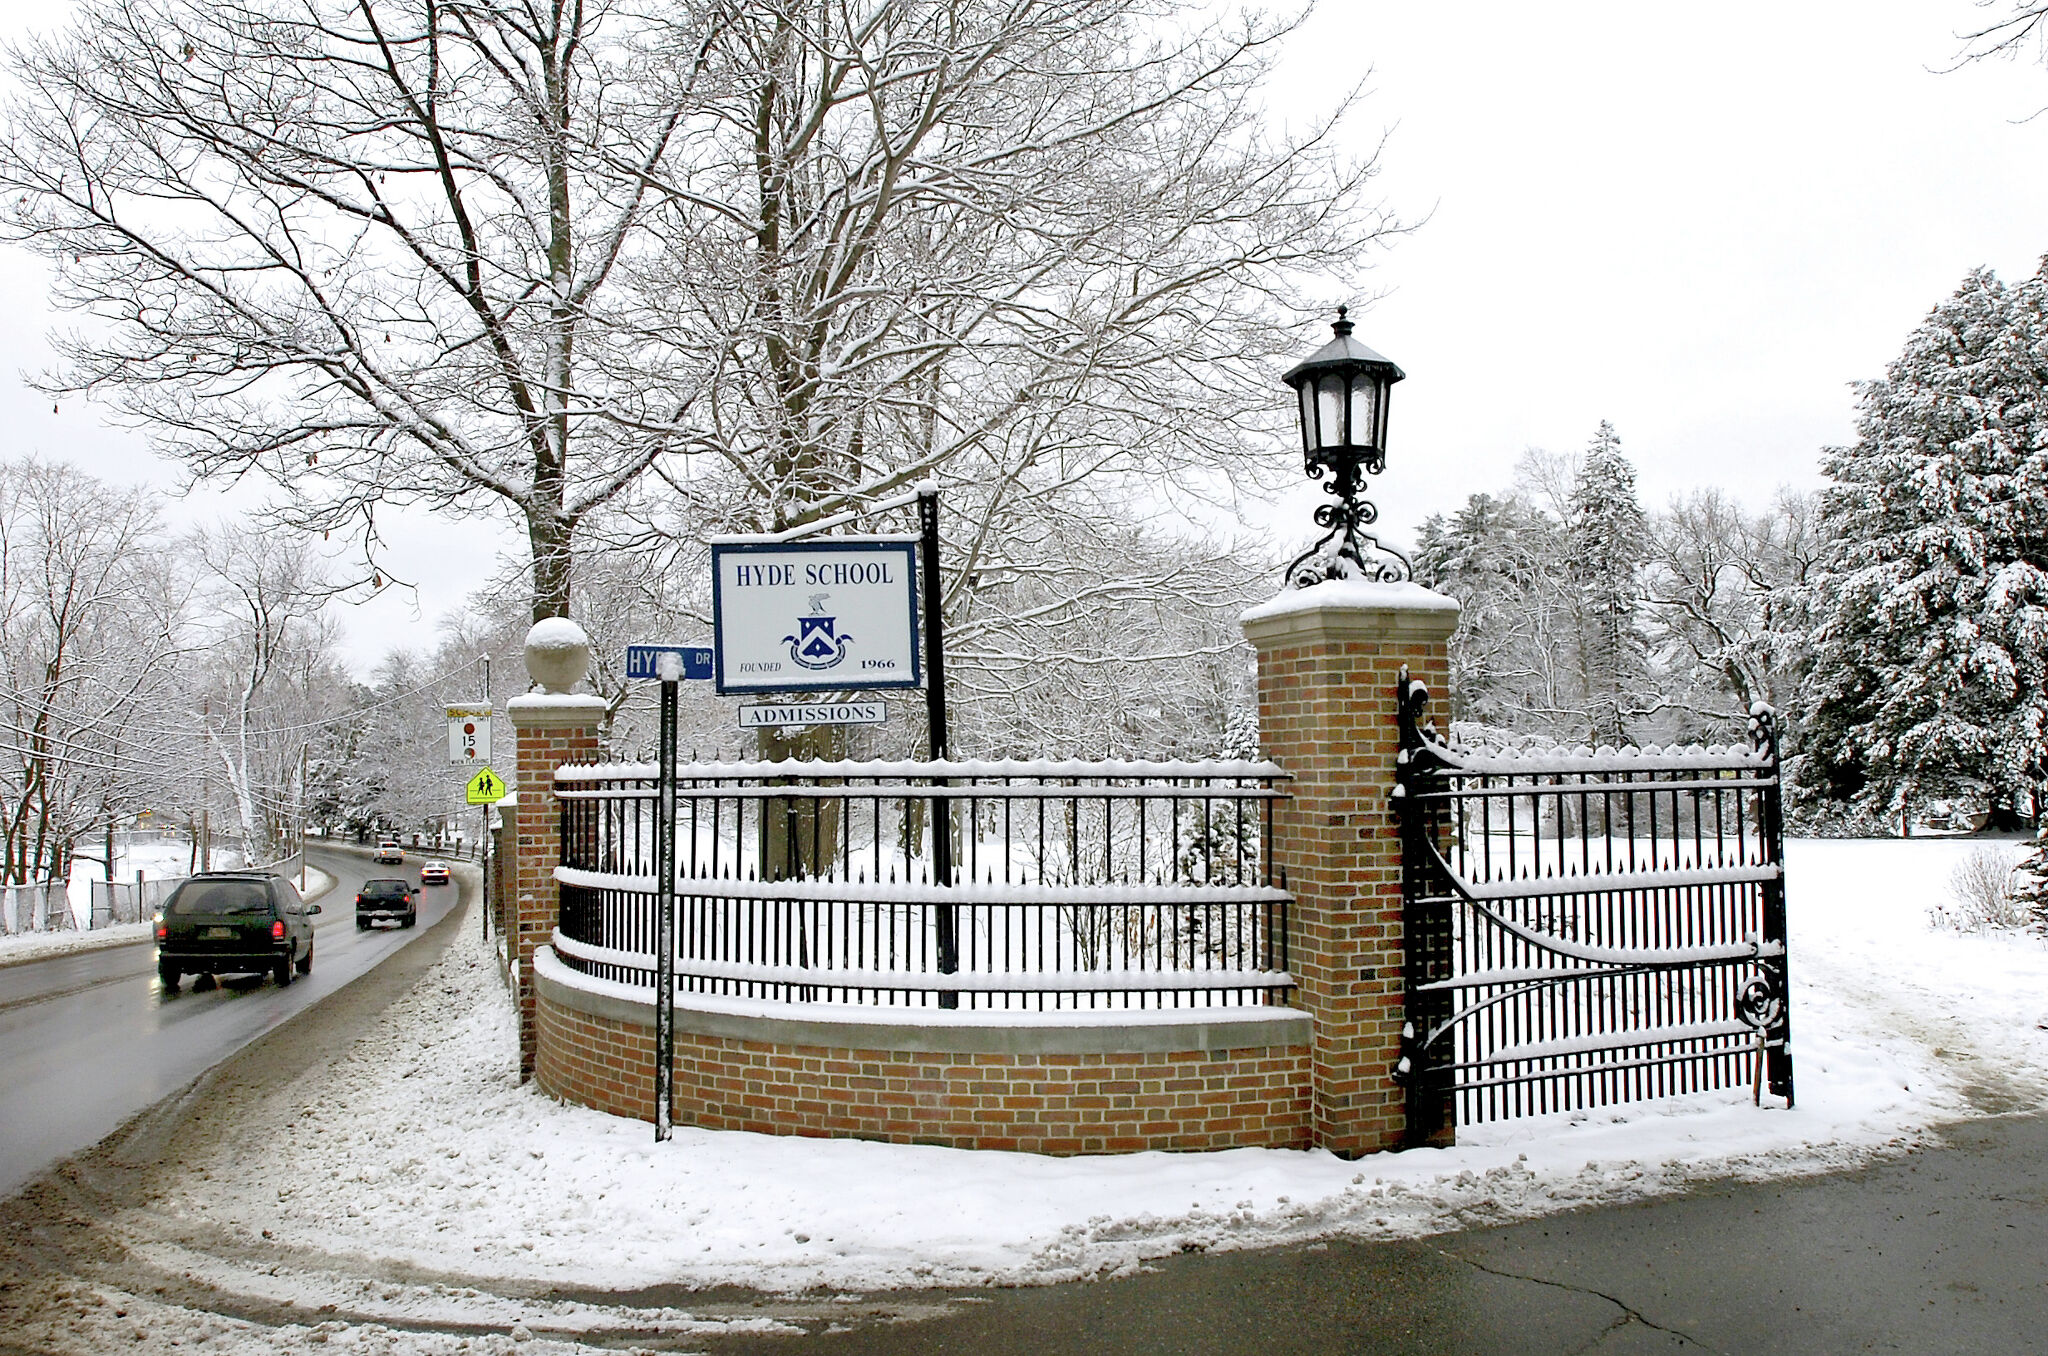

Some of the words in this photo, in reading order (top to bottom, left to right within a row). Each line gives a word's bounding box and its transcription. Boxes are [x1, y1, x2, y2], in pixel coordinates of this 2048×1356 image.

[736, 564, 796, 587] HYDE
[805, 562, 894, 585] SCHOOL
[629, 650, 664, 674] HY
[695, 652, 711, 665] DR
[739, 662, 782, 673] FOUNDED
[861, 659, 896, 669] 1966
[750, 706, 877, 724] ADMISSIONS
[462, 735, 476, 747] 15
